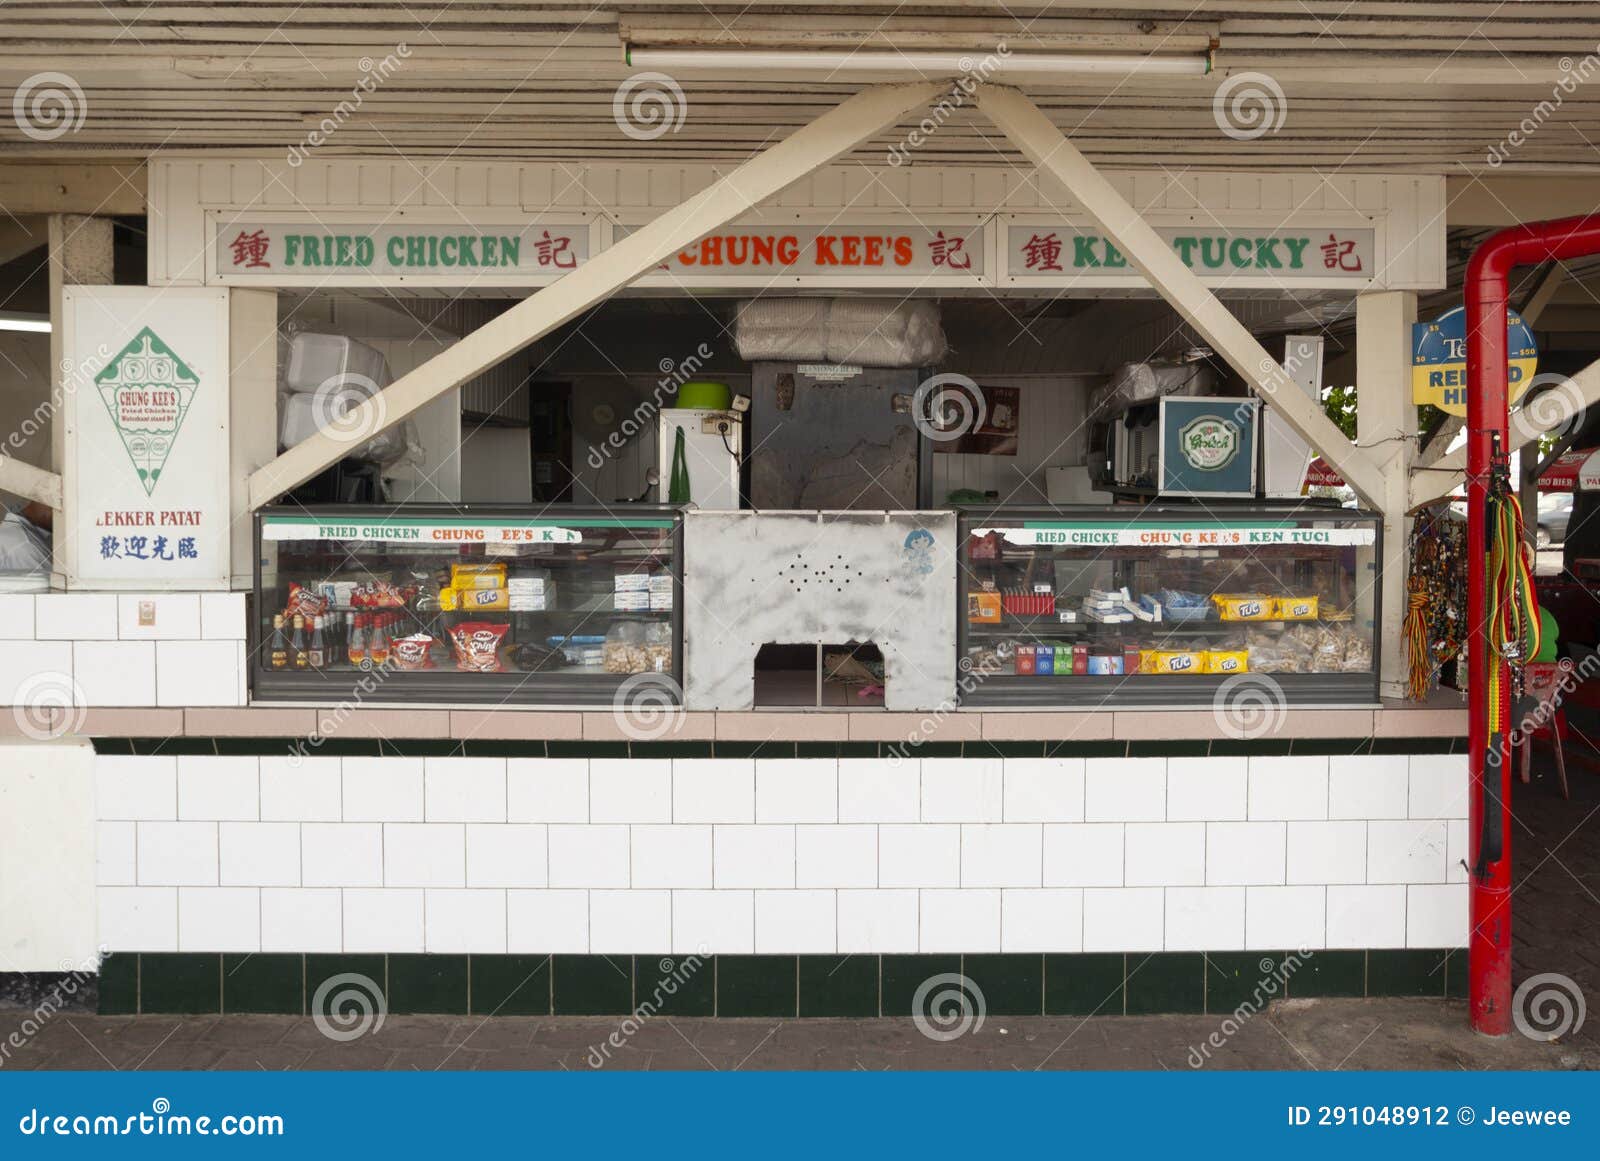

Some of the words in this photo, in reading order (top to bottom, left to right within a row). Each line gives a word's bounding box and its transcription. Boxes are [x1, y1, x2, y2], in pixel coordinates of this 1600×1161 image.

[284, 235, 375, 267] FRIED
[386, 236, 521, 267] CHICKEN
[534, 230, 577, 269] 記
[678, 235, 799, 267] CHUNG
[814, 236, 913, 267] KEE'S
[928, 230, 971, 269] 記
[1320, 232, 1363, 272] 記
[120, 391, 149, 406] CHUNG
[160, 511, 202, 526] PATAT
[320, 527, 357, 537] FRIED
[362, 527, 420, 538] CHICKEN
[432, 529, 485, 540] CHUNG
[1140, 532, 1192, 544] CHUNG
[1239, 603, 1261, 617] TUC
[1170, 656, 1191, 670] TUC
[1222, 659, 1237, 671] TUC
